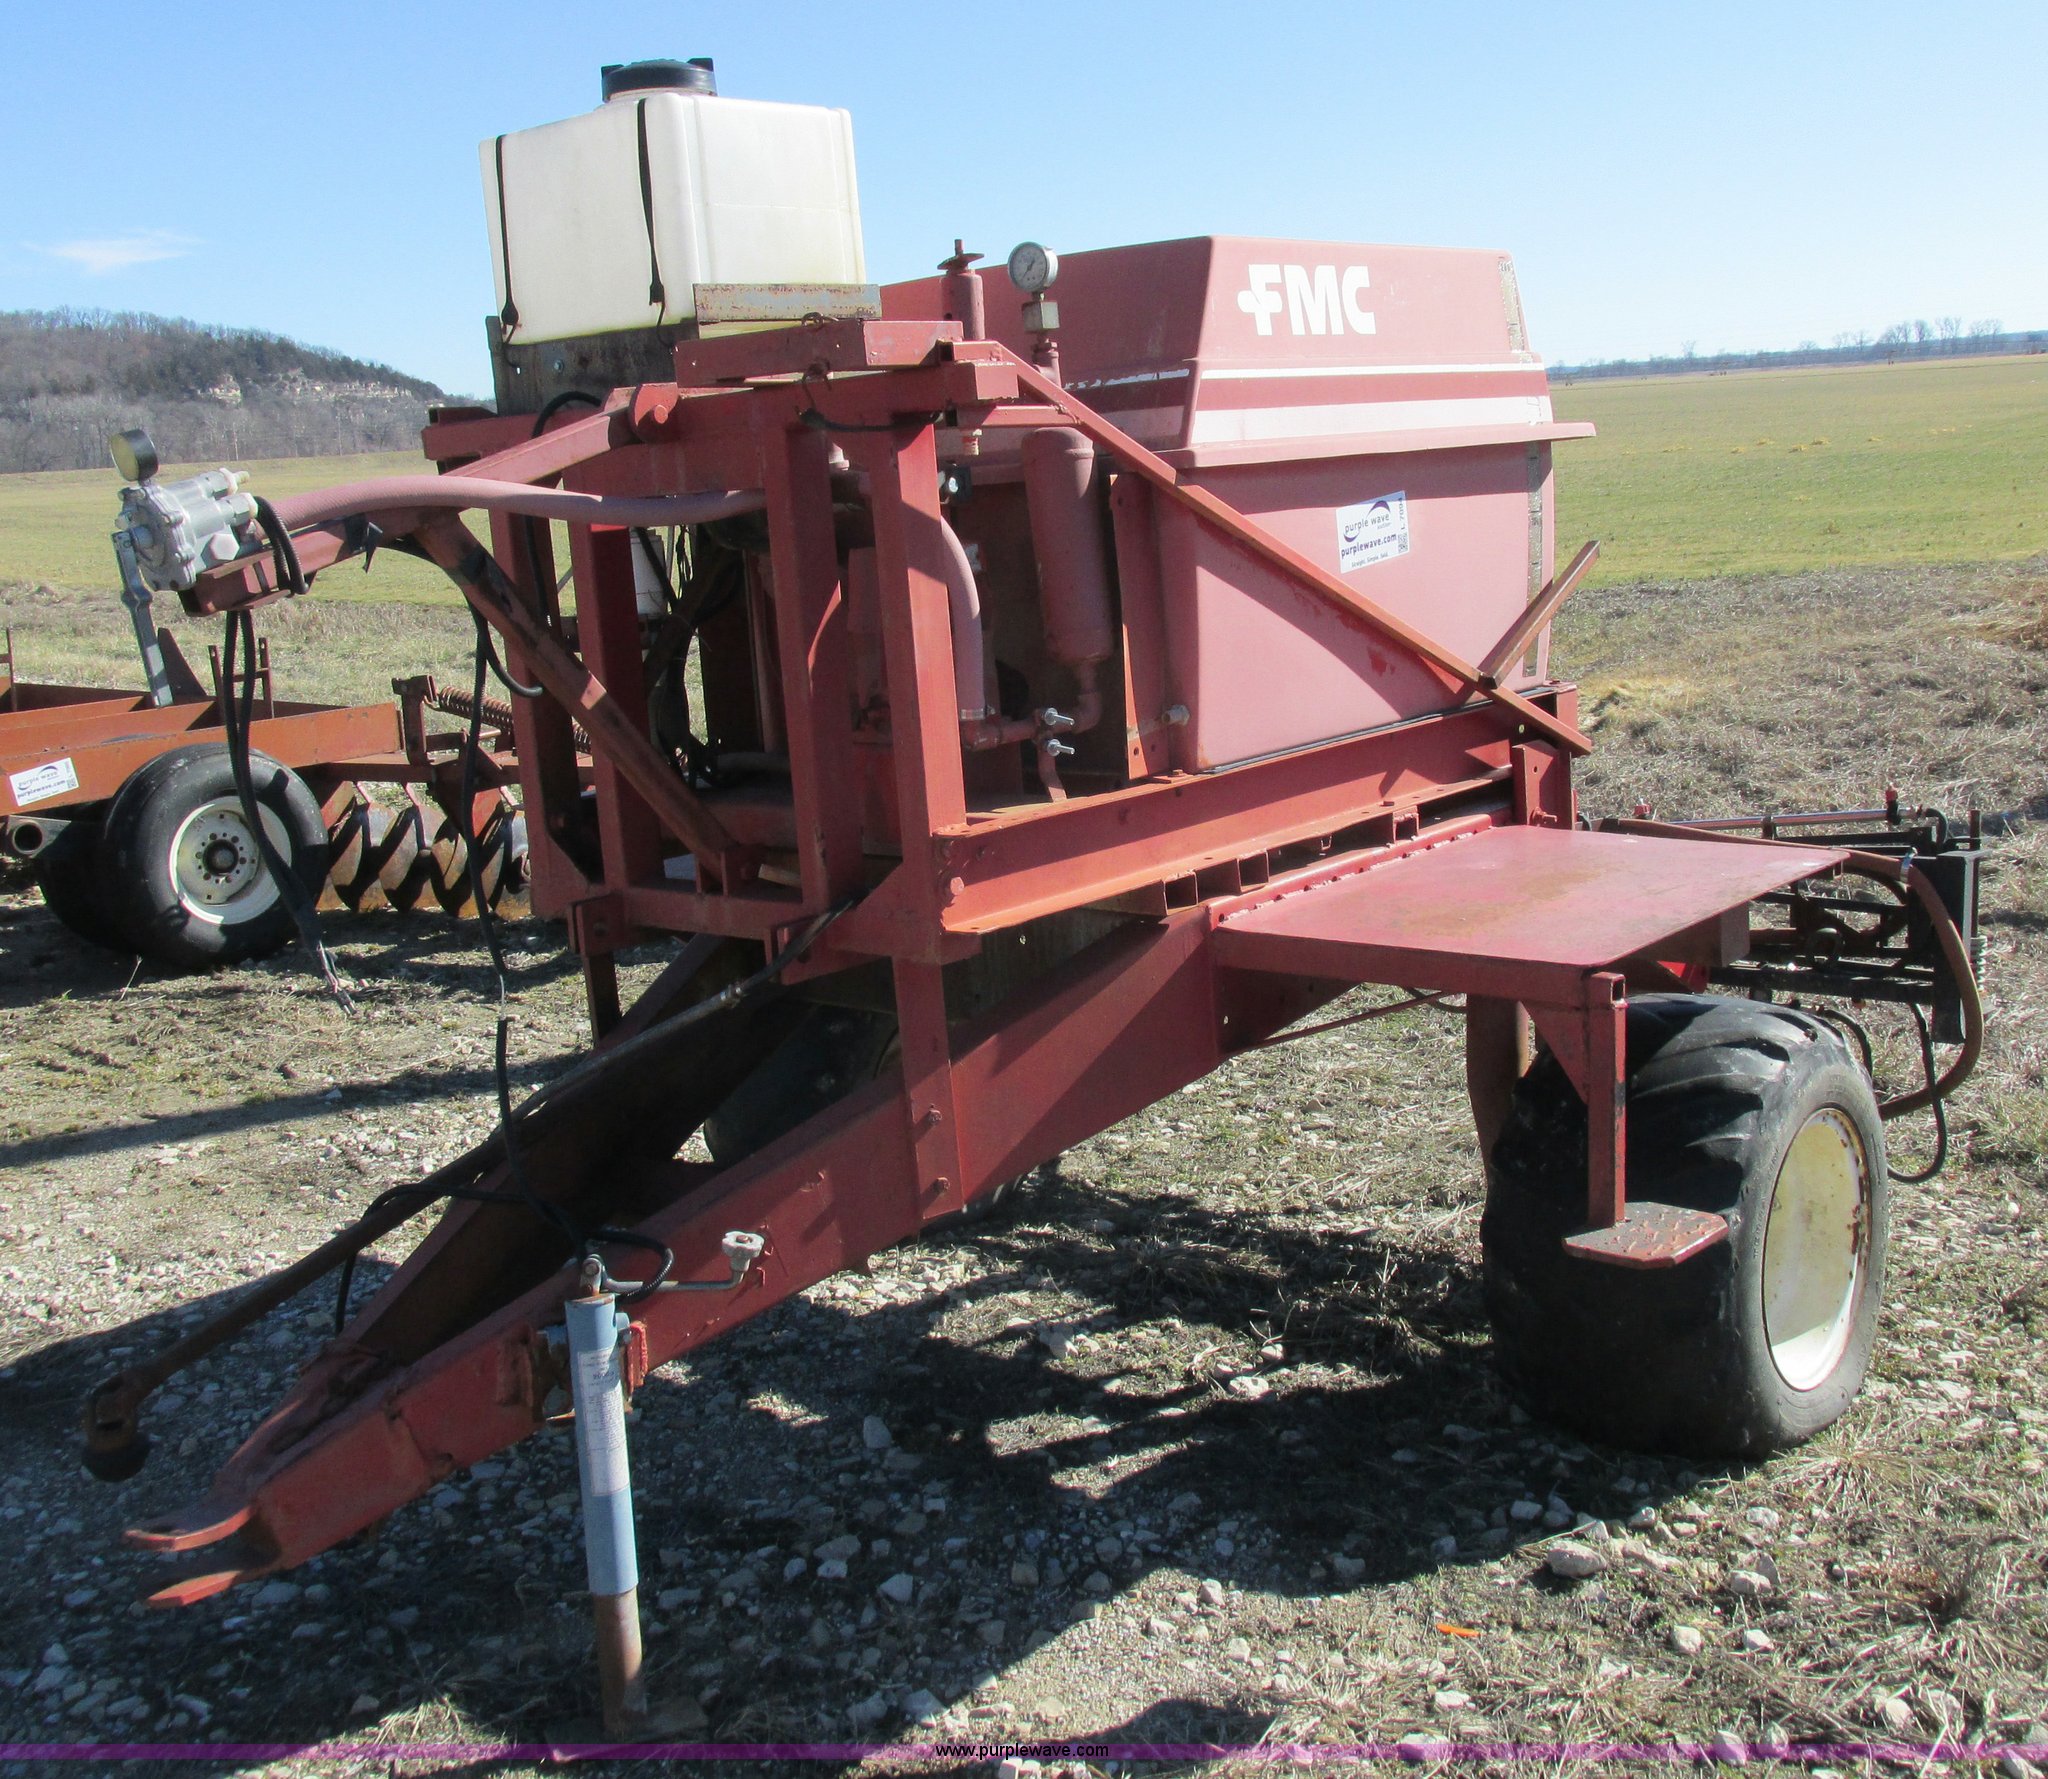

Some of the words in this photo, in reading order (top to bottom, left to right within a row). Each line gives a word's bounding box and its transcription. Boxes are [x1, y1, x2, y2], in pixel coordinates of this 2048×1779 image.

[1237, 264, 1377, 336] FMC
[1345, 519, 1368, 533] purple
[1371, 514, 1389, 525] wave
[1341, 533, 1397, 559] purplewave.com
